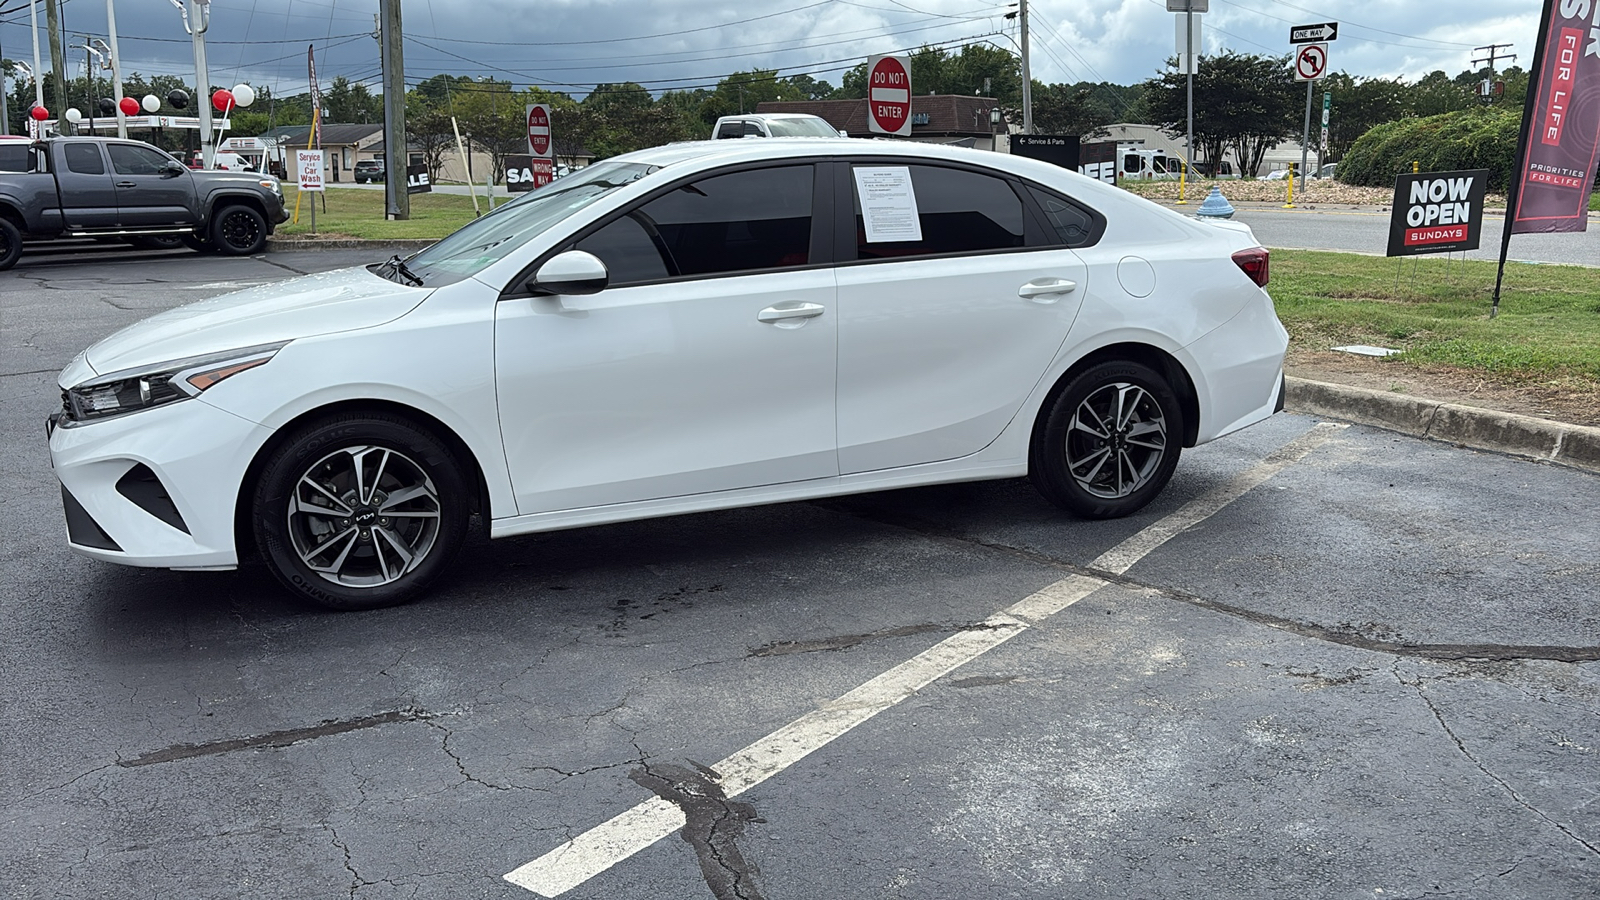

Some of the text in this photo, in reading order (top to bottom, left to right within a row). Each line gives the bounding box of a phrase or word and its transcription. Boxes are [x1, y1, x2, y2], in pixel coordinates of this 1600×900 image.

[874, 72, 904, 84] DO NOT
[1547, 35, 1576, 140] FOR LIFE
[878, 106, 902, 118] ENTER
[300, 153, 320, 162] Service
[534, 164, 552, 174] WRONG
[1530, 163, 1584, 178] PRIORITIES
[537, 176, 549, 186] WAY
[1532, 173, 1578, 186] FOR LIFE
[1409, 177, 1474, 204] NOW
[1406, 202, 1470, 227] OPEN
[1411, 229, 1462, 240] SUNDAYS
